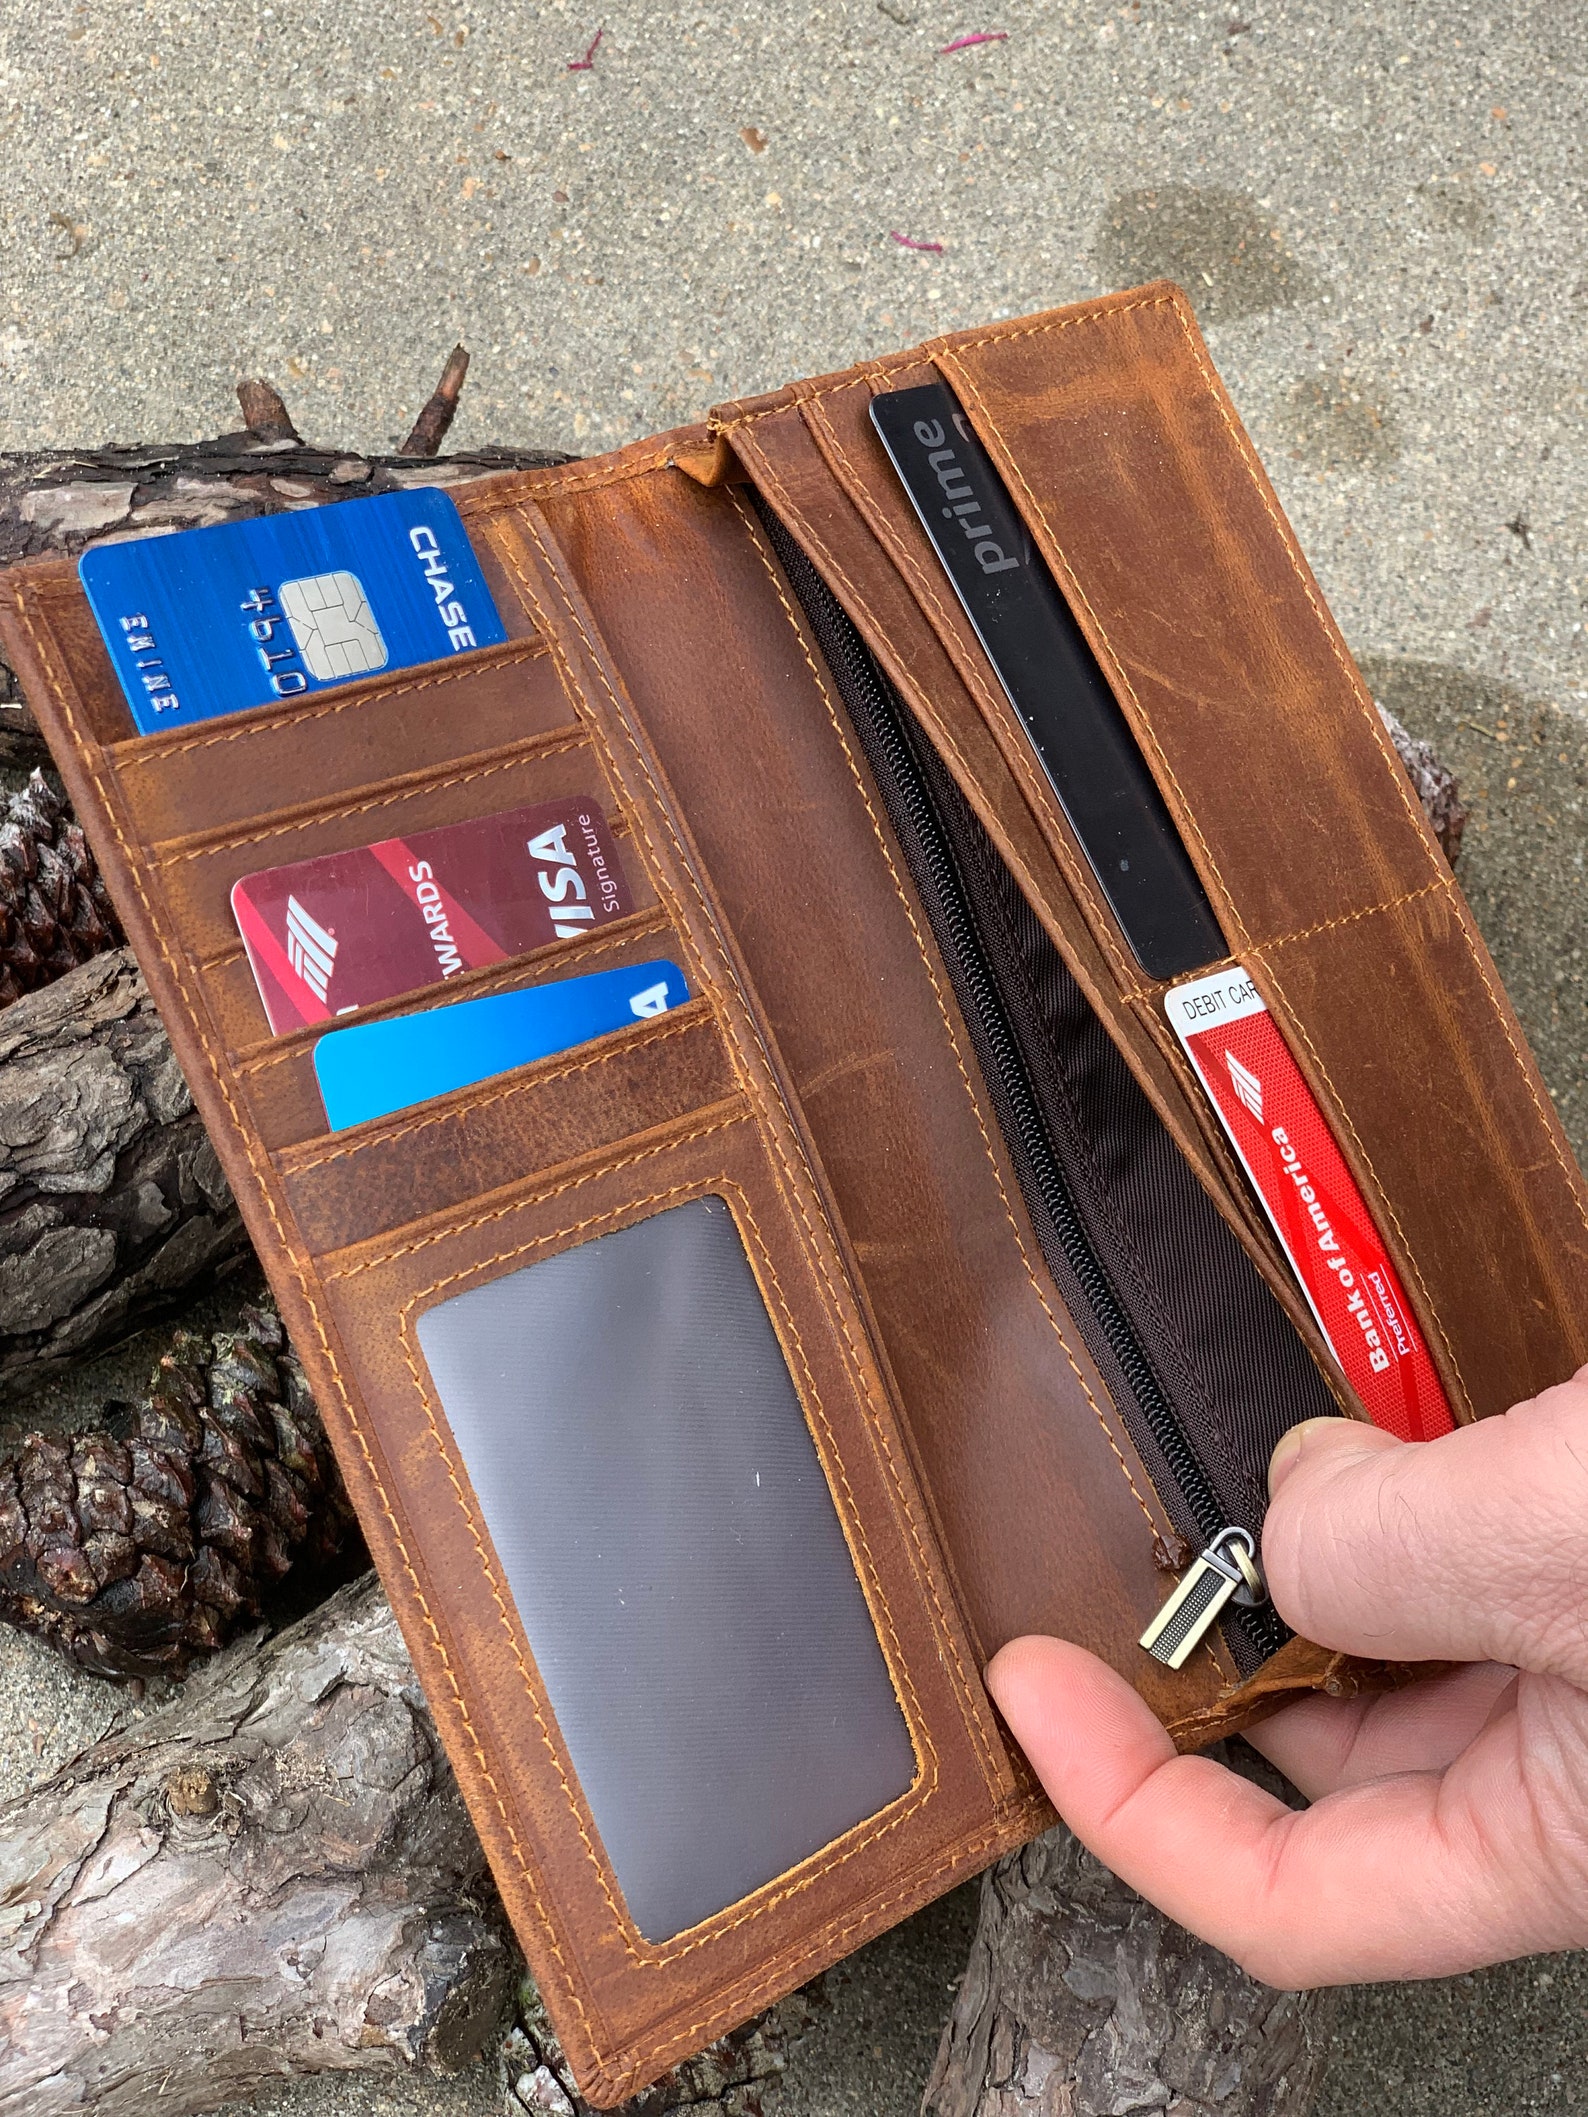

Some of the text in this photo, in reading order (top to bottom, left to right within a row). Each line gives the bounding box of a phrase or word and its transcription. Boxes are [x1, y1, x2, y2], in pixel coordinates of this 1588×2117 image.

[913, 418, 1020, 574] prime
[240, 586, 307, 697] 4610
[409, 526, 477, 651] CHASE
[119, 612, 179, 713] EMINE
[579, 814, 620, 912] Signature
[409, 860, 465, 980] WARDS
[1182, 990, 1227, 1020] DEBIT
[1271, 1126, 1390, 1373] Bank of America
[1367, 1271, 1410, 1355] Preferred
